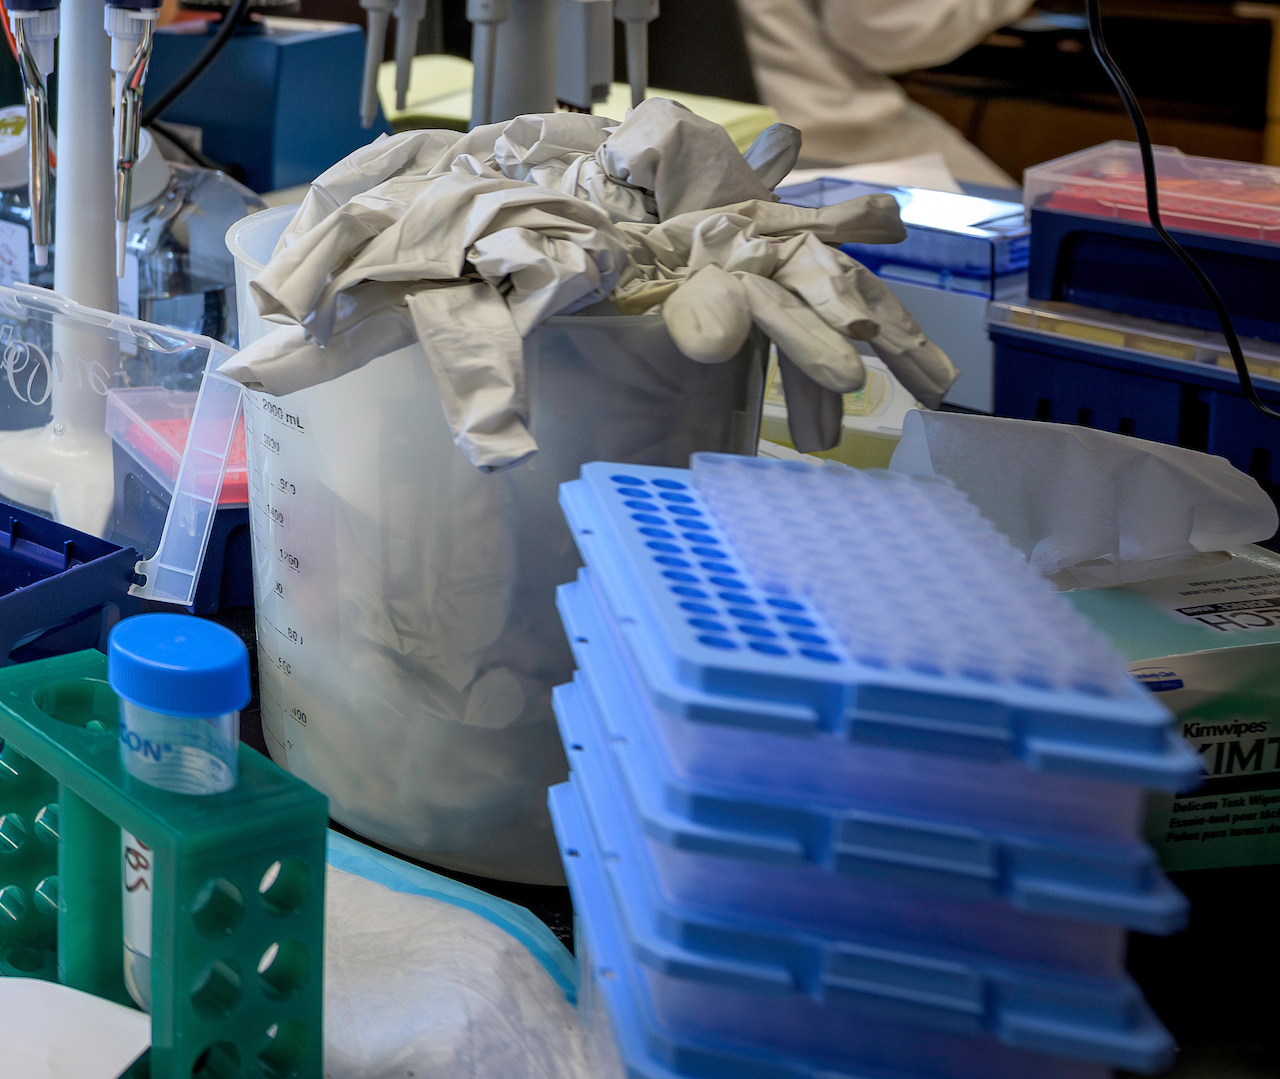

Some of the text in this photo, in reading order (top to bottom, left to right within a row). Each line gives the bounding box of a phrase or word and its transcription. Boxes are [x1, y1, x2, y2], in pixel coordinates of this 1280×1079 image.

[285, 412, 305, 431] mL
[1183, 719, 1268, 739] Kimwipes
[1173, 801, 1218, 814] Delicate
[1222, 797, 1246, 808] Task
